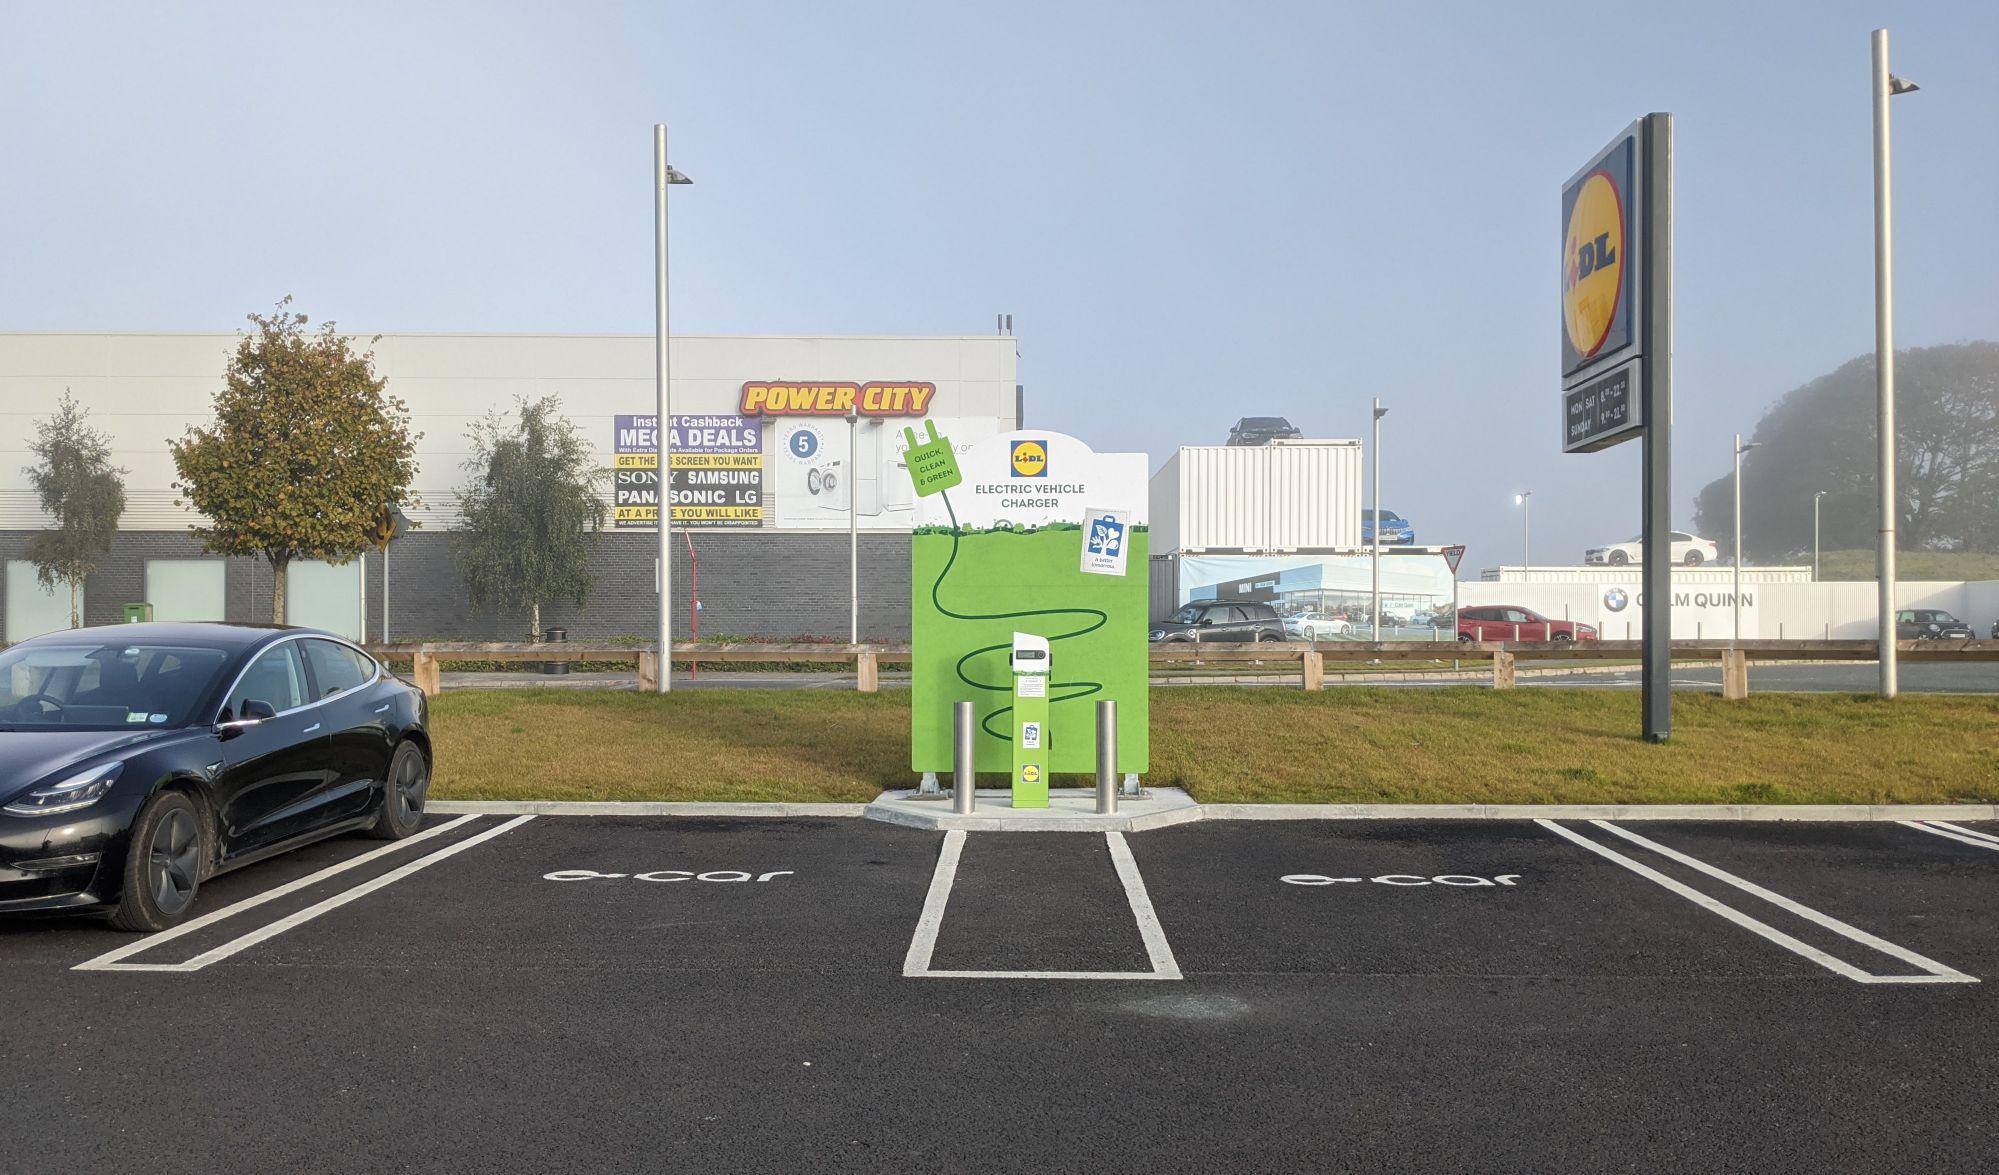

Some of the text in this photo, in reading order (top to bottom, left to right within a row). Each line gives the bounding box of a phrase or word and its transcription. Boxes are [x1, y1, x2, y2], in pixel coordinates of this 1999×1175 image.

[745, 387, 929, 410] POWER CITY
[1585, 395, 1595, 409] SAT
[633, 416, 744, 427] Instt Cashback
[1571, 419, 1591, 437] SUNDAY
[688, 428, 757, 446] DEALS
[798, 436, 809, 452] 5
[618, 456, 636, 466] GET
[638, 456, 656, 466] THE
[675, 456, 710, 466] SCREEN
[712, 456, 731, 466] YOU
[733, 456, 759, 466] WANT
[919, 459, 946, 473] CLEAN
[687, 471, 760, 484] SAMSUNG
[920, 469, 954, 486] & GREEN
[975, 484, 1085, 494] ELECTRIC VEHICLE
[618, 490, 757, 504] PANSONIC LG
[1001, 498, 1059, 508] CHARGER
[618, 508, 759, 518] AT A PRE YOU WILL LIKE
[1694, 593, 1753, 609] QUINN
